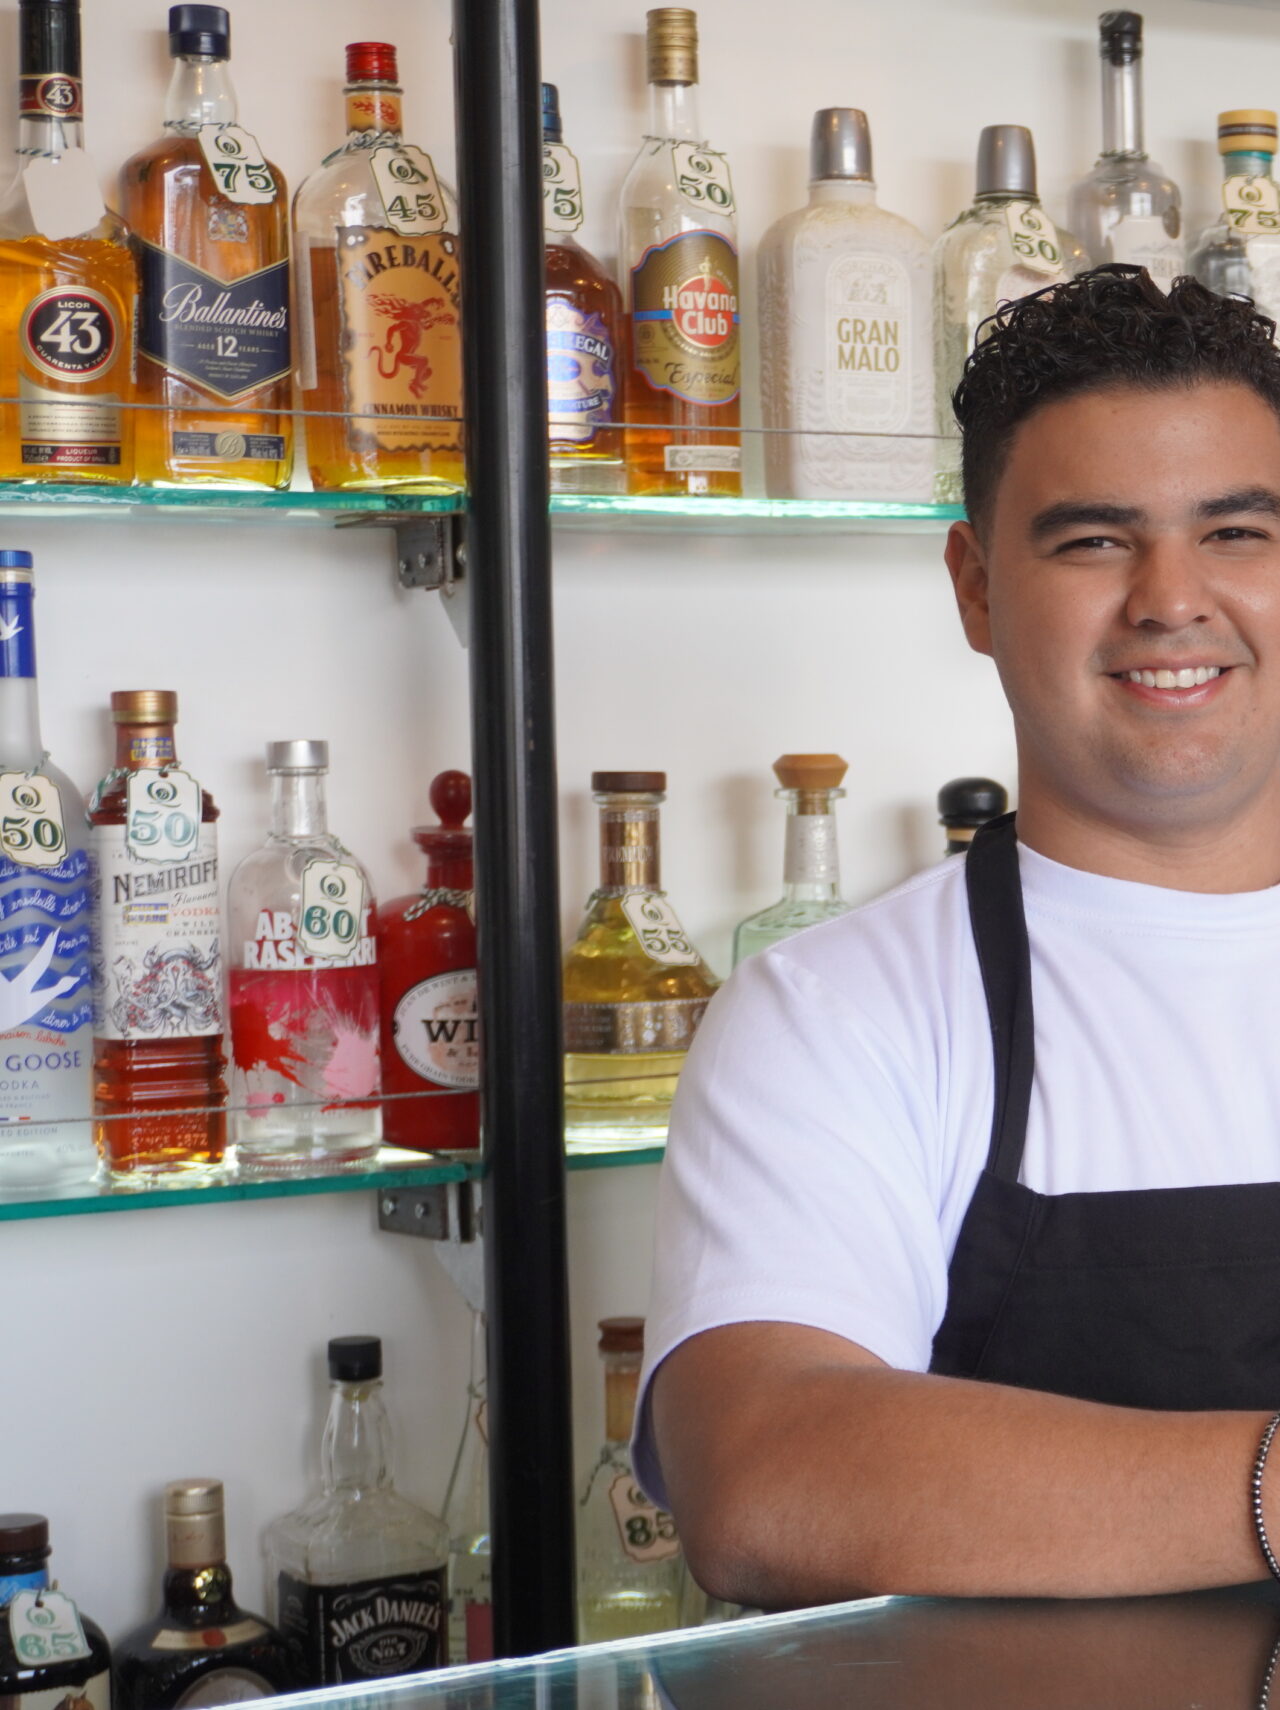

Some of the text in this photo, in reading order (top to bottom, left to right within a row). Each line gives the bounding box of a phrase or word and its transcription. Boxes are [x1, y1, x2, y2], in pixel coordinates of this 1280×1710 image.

[46, 84, 73, 105] 43
[213, 163, 277, 193] 75
[680, 174, 732, 208] 50
[387, 193, 441, 222] 45
[543, 187, 583, 220] 5
[1226, 208, 1280, 228] 75
[1012, 232, 1060, 266] 50
[58, 301, 90, 309] LICOR
[159, 282, 287, 328] Ballantine's
[663, 285, 738, 313] Havana
[40, 310, 101, 354] 43
[174, 323, 280, 337] BLENDED SCOTCH WHISKY
[681, 310, 728, 336] Club
[837, 318, 899, 346] GRAN
[36, 344, 83, 370] CUARENTA
[216, 335, 238, 357] 12
[837, 344, 900, 373] MALO
[664, 362, 738, 389] Especial
[421, 404, 459, 418] WHISKY
[2, 815, 64, 852] 50
[130, 810, 195, 847] 50
[113, 858, 218, 905] NEMIROFF
[304, 905, 359, 944] 60
[641, 928, 693, 955] 55
[421, 1018, 479, 1043] WI
[5, 1050, 82, 1072] GOOSE
[0, 1080, 40, 1092] ODKA
[17, 1127, 58, 1138] EDITION
[625, 1511, 678, 1551] 85
[330, 1596, 441, 1648] JACK DANIEL'S
[18, 1633, 80, 1659] 65
